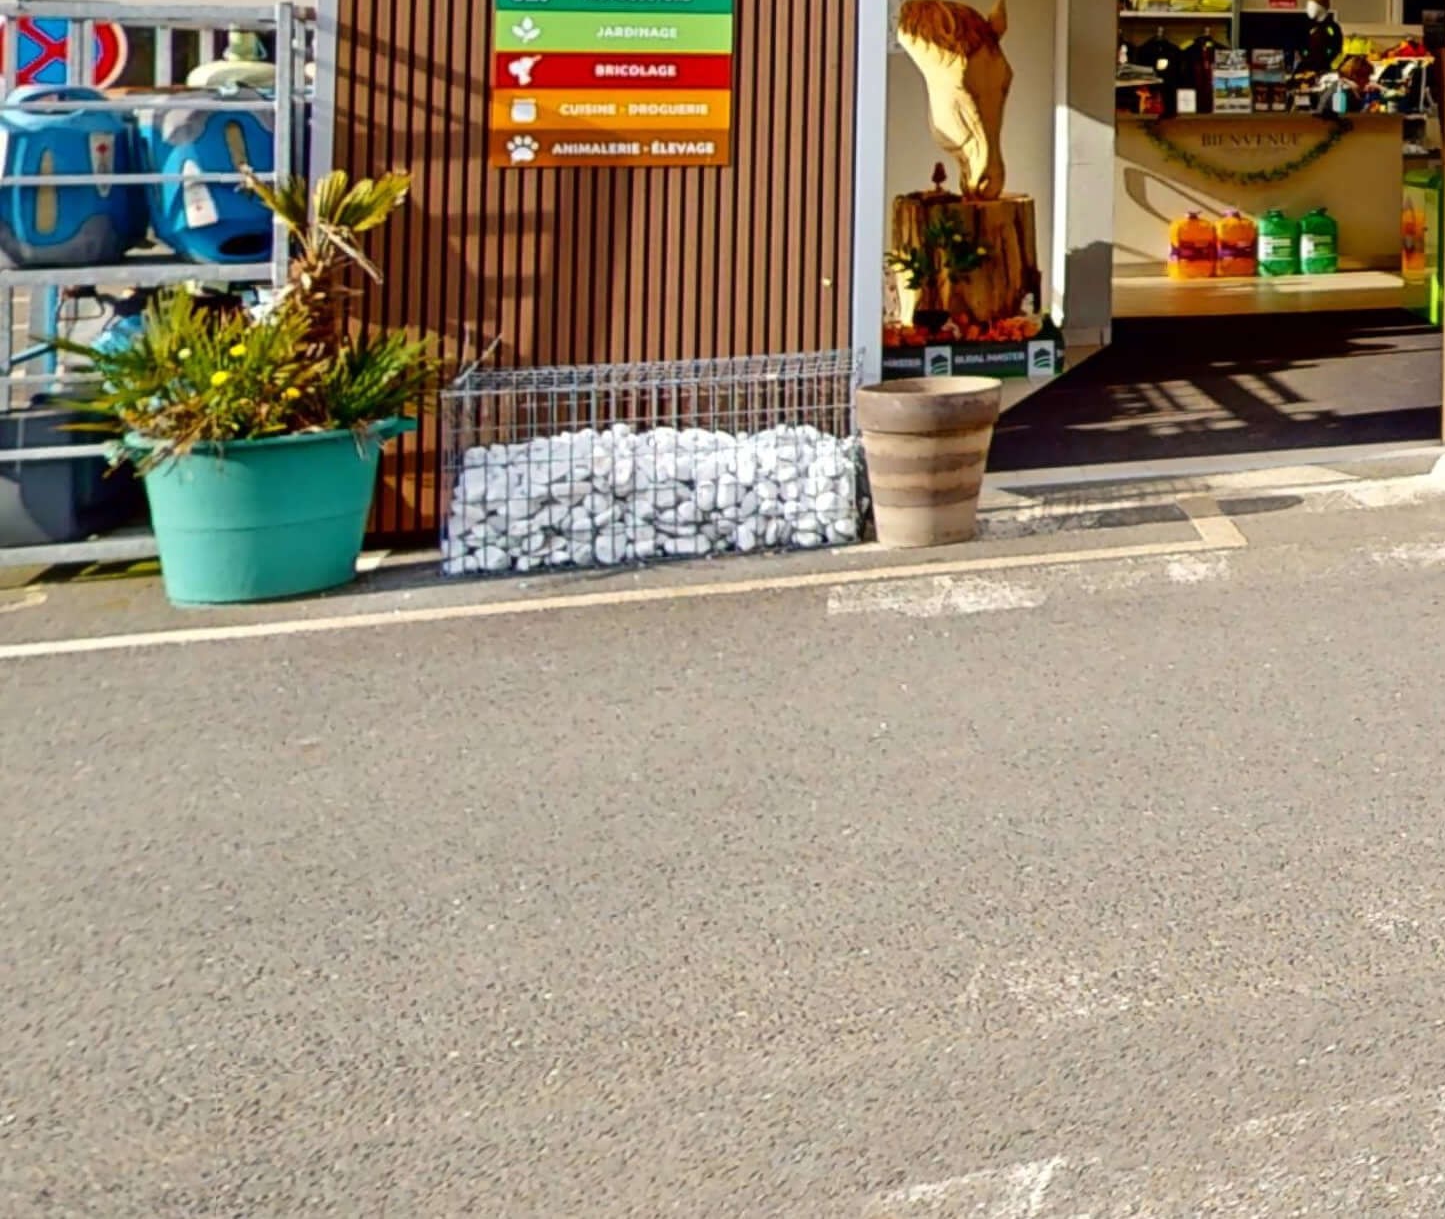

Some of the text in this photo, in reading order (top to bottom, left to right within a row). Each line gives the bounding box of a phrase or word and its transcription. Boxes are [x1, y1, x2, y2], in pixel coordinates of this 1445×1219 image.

[596, 25, 678, 38] JARDINAGE
[594, 63, 677, 77] BRICOLAGE
[559, 103, 617, 116] CUISINE
[628, 103, 708, 116] DROGUERIE
[551, 142, 641, 155] ANIMALERIE
[651, 139, 715, 155] ÉLEVAGE
